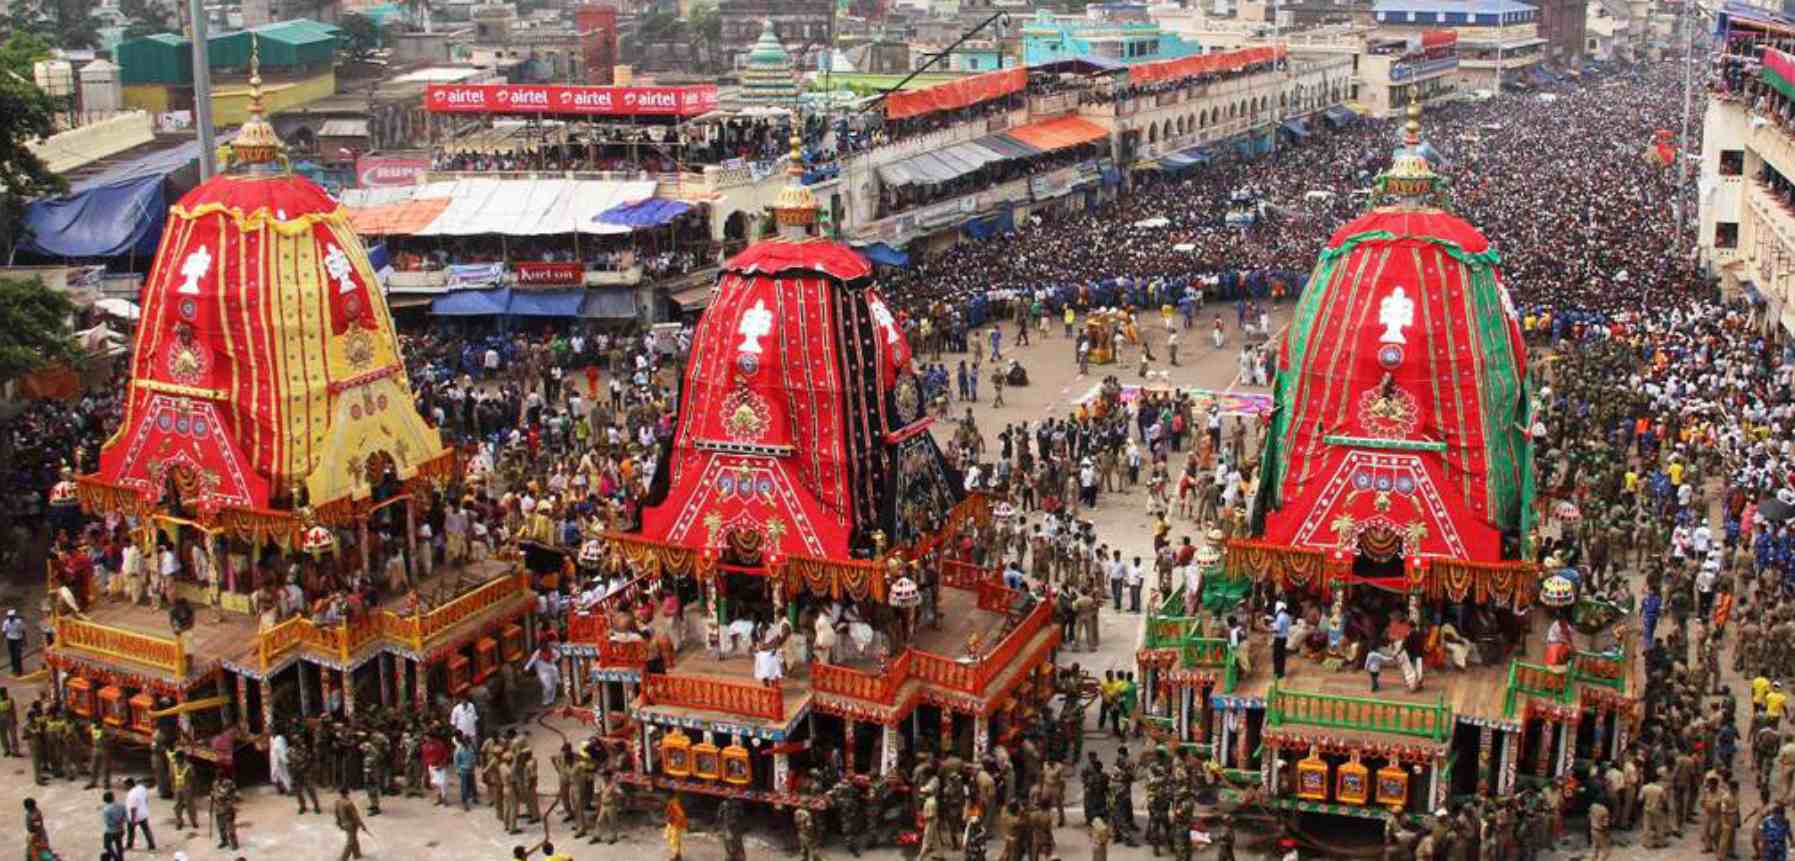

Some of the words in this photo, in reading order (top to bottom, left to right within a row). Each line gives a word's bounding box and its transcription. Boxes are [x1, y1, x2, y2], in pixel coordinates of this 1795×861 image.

[447, 89, 485, 103] airtel
[510, 89, 548, 104] airtel
[575, 91, 612, 105] airtel
[638, 92, 676, 106] airtel
